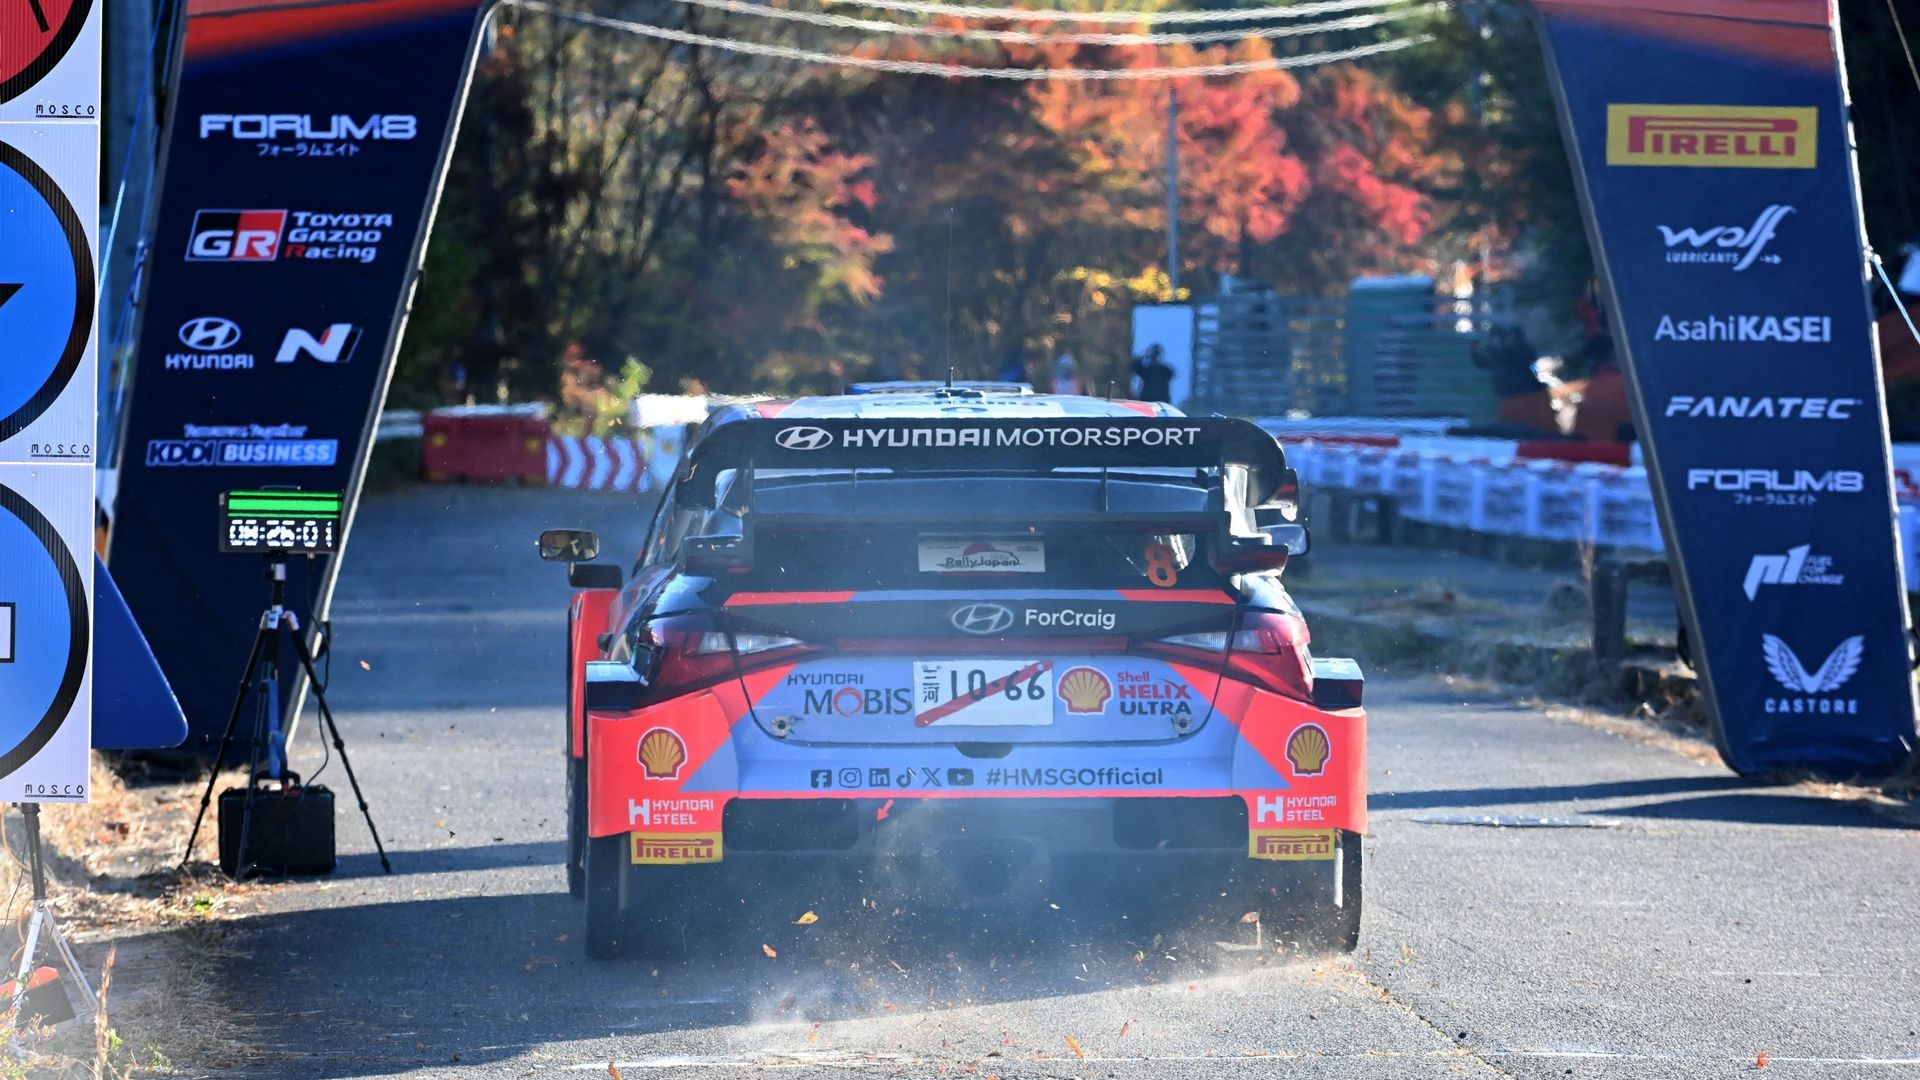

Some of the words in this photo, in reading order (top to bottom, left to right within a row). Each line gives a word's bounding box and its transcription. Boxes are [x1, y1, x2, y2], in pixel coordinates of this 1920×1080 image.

[36, 105, 95, 114] MOSCO
[200, 114, 417, 139] FORUM8
[1628, 116, 1798, 156] PIRELLI
[257, 143, 360, 156] フォーラムエイト
[292, 211, 393, 227] TOYOTA
[192, 230, 277, 256] GR
[288, 228, 381, 243] GAZOO
[285, 244, 376, 263] Racing
[1666, 252, 1740, 264] LUBRICANTS
[165, 354, 254, 369] HYUNDAI
[1665, 396, 1855, 419] FANATEC
[842, 428, 990, 448] HYUNDAI
[997, 427, 1202, 447] MOTORSPORT
[31, 444, 90, 454] MOSCO
[148, 441, 215, 464] KDDI
[223, 444, 331, 462] BUSINESS
[1687, 469, 1864, 492] FORUM8
[1144, 543, 1177, 587] 8
[1025, 608, 1116, 630] ForCraig
[787, 673, 864, 685] HYUNDAI
[1117, 671, 1149, 682] Shell
[922, 669, 940, 703] 三河
[1118, 679, 1192, 699] HELIX
[803, 687, 913, 717] MOBIS
[1120, 701, 1192, 715] ULTRA
[1765, 698, 1858, 714] CASTORE
[986, 767, 1163, 787] #HMSGOfficial
[25, 784, 84, 794] MOSCO
[653, 800, 714, 811] HYUNDAI
[1287, 796, 1336, 807] HYUNDAI
[653, 813, 697, 825] STEEL
[1287, 810, 1325, 821] STEEL
[636, 838, 714, 858] PIRELLI
[1257, 835, 1330, 854] PIRELLI
